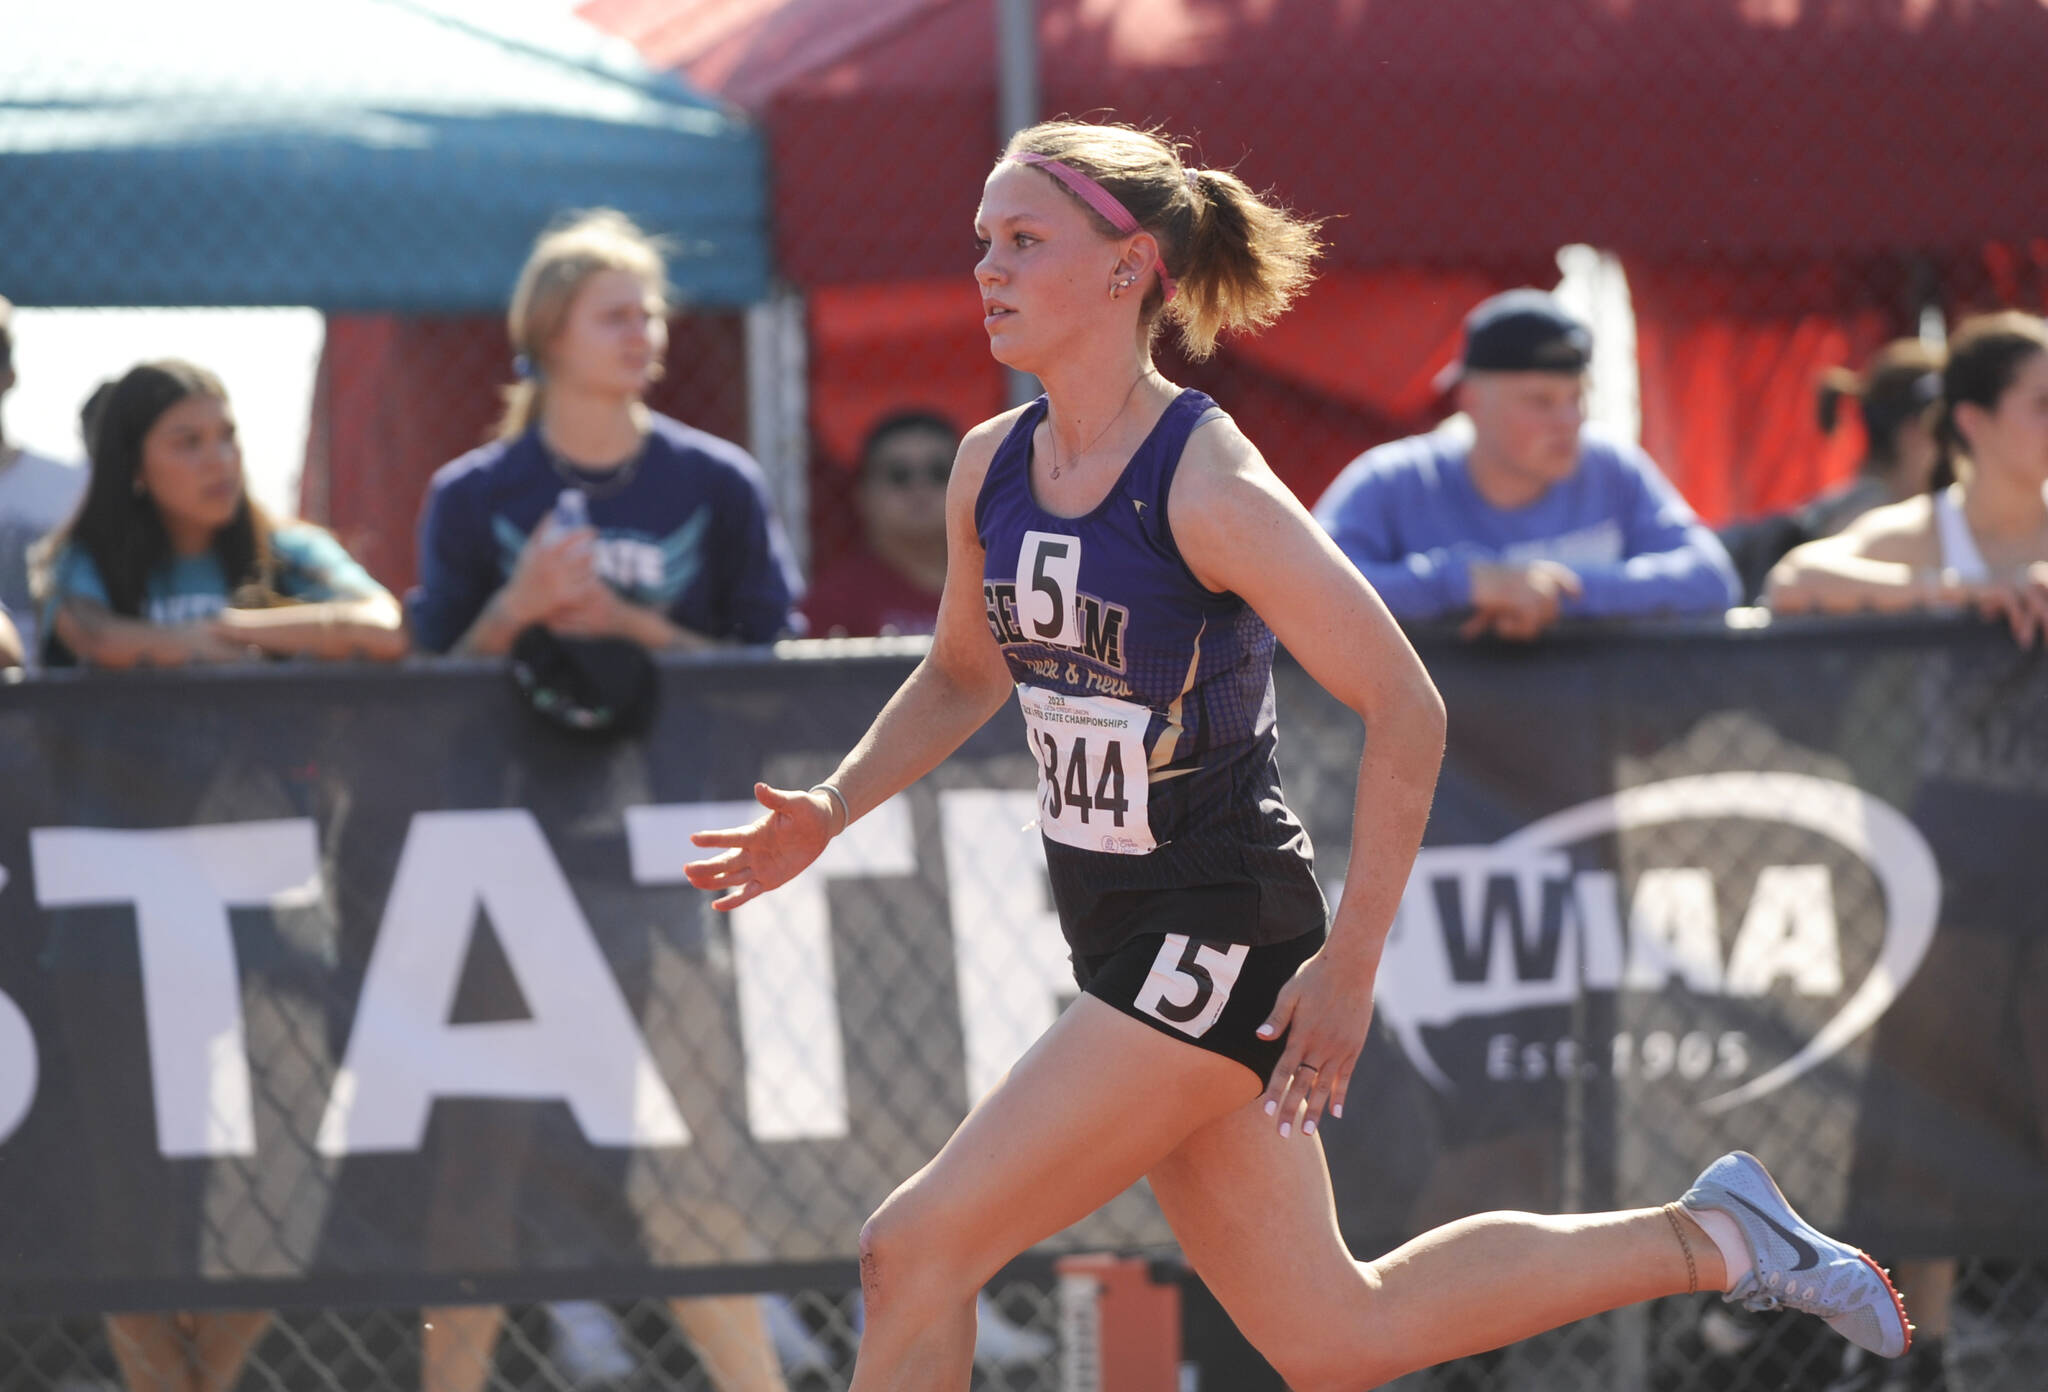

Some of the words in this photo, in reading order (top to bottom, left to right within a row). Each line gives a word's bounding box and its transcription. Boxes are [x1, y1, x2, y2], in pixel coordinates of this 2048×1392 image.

[1032, 540, 1069, 639] 5
[1065, 661, 1080, 685] &
[1044, 711, 1064, 723] STATE
[1065, 714, 1129, 729] CHAMPIONSHIPS
[1048, 695, 1065, 706] 2023
[1429, 863, 1844, 997] WIAA
[1155, 935, 1230, 1023] 5
[1611, 1030, 1749, 1082] 1905
